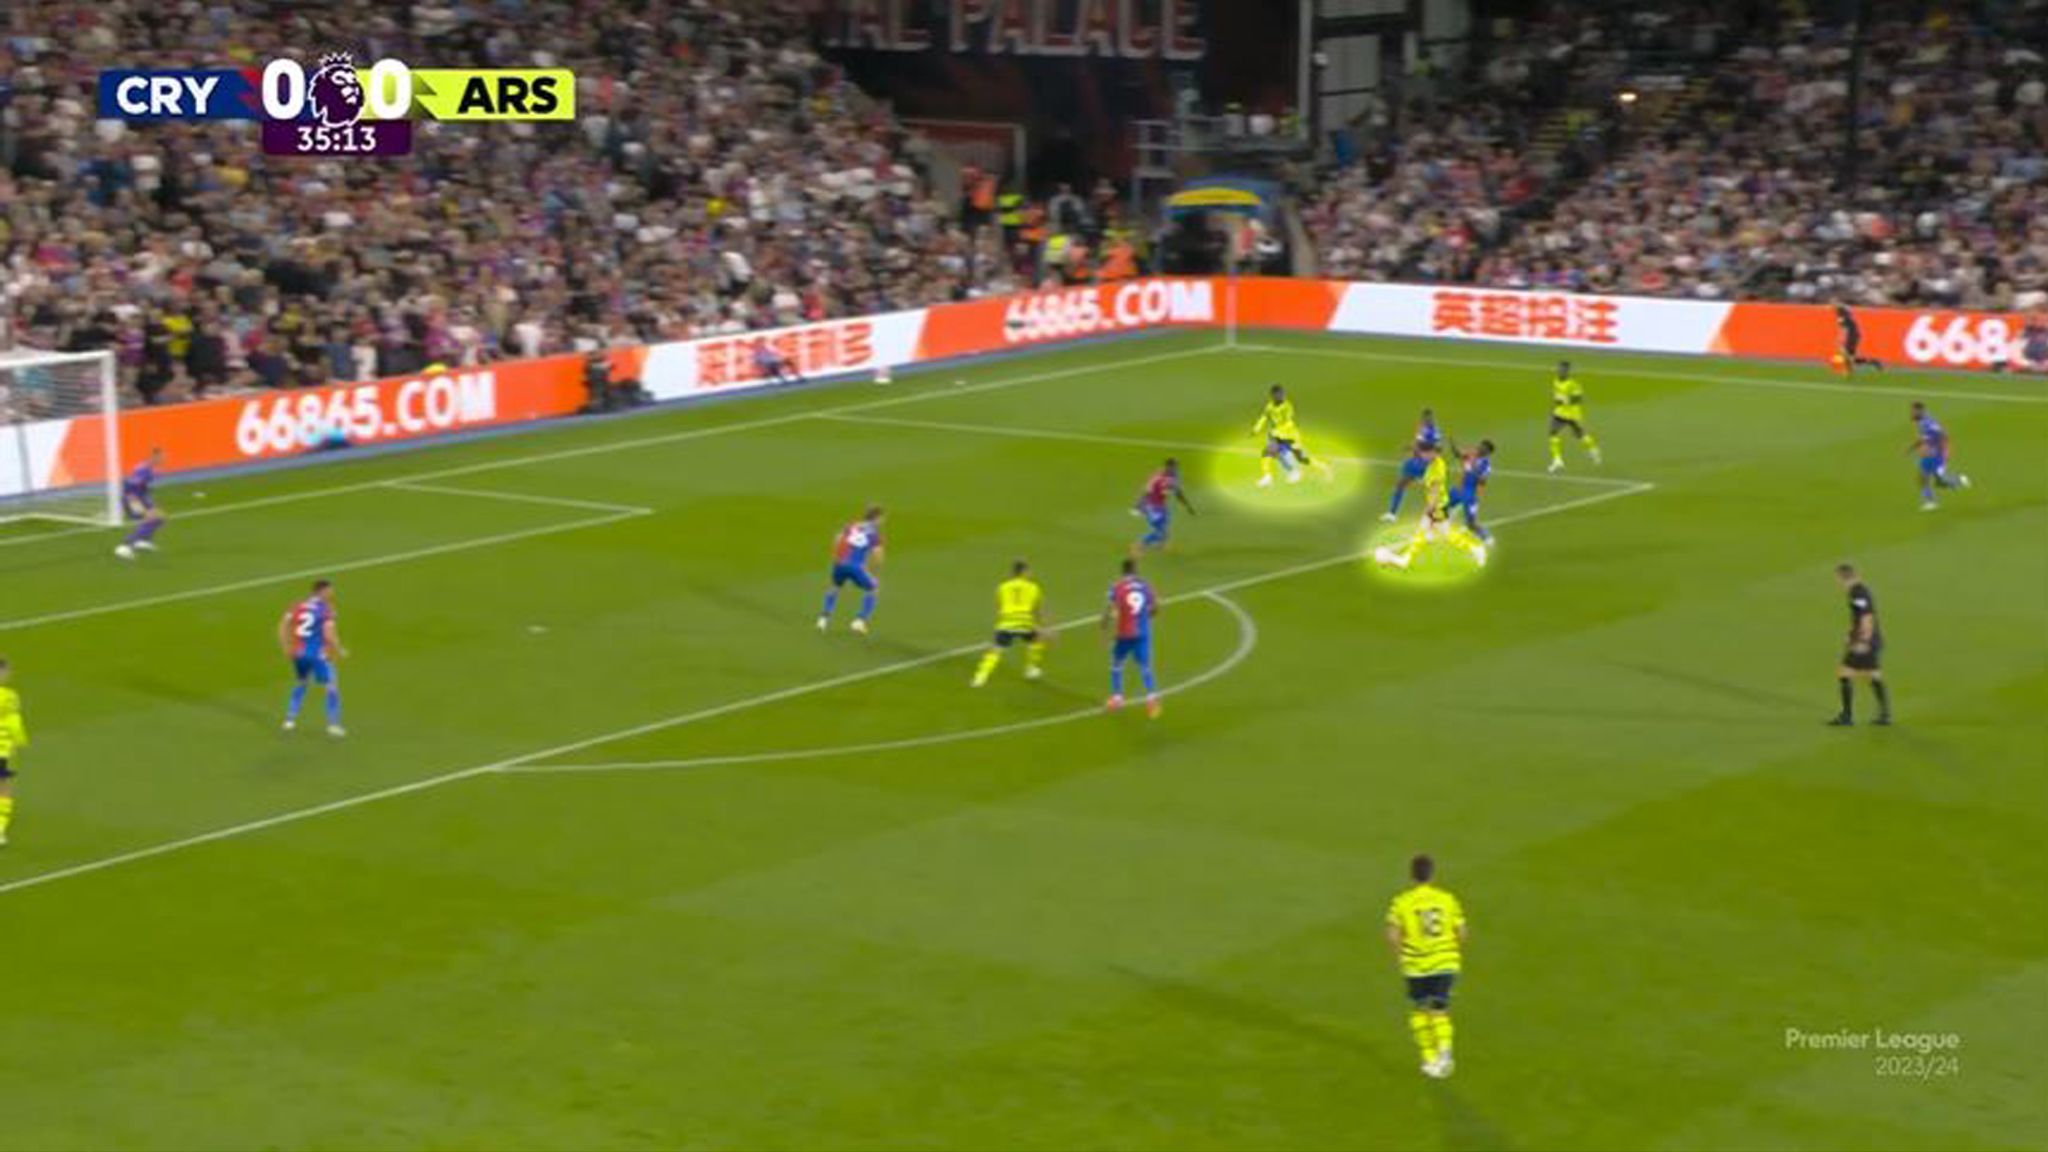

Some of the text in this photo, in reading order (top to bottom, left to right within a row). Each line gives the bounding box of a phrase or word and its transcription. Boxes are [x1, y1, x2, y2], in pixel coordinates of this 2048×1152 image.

[950, 0, 1206, 60] PALACE
[1905, 315, 2031, 366] 668
[236, 371, 496, 456] 66865.COM
[296, 612, 315, 637] 2
[1126, 591, 1145, 615] 9
